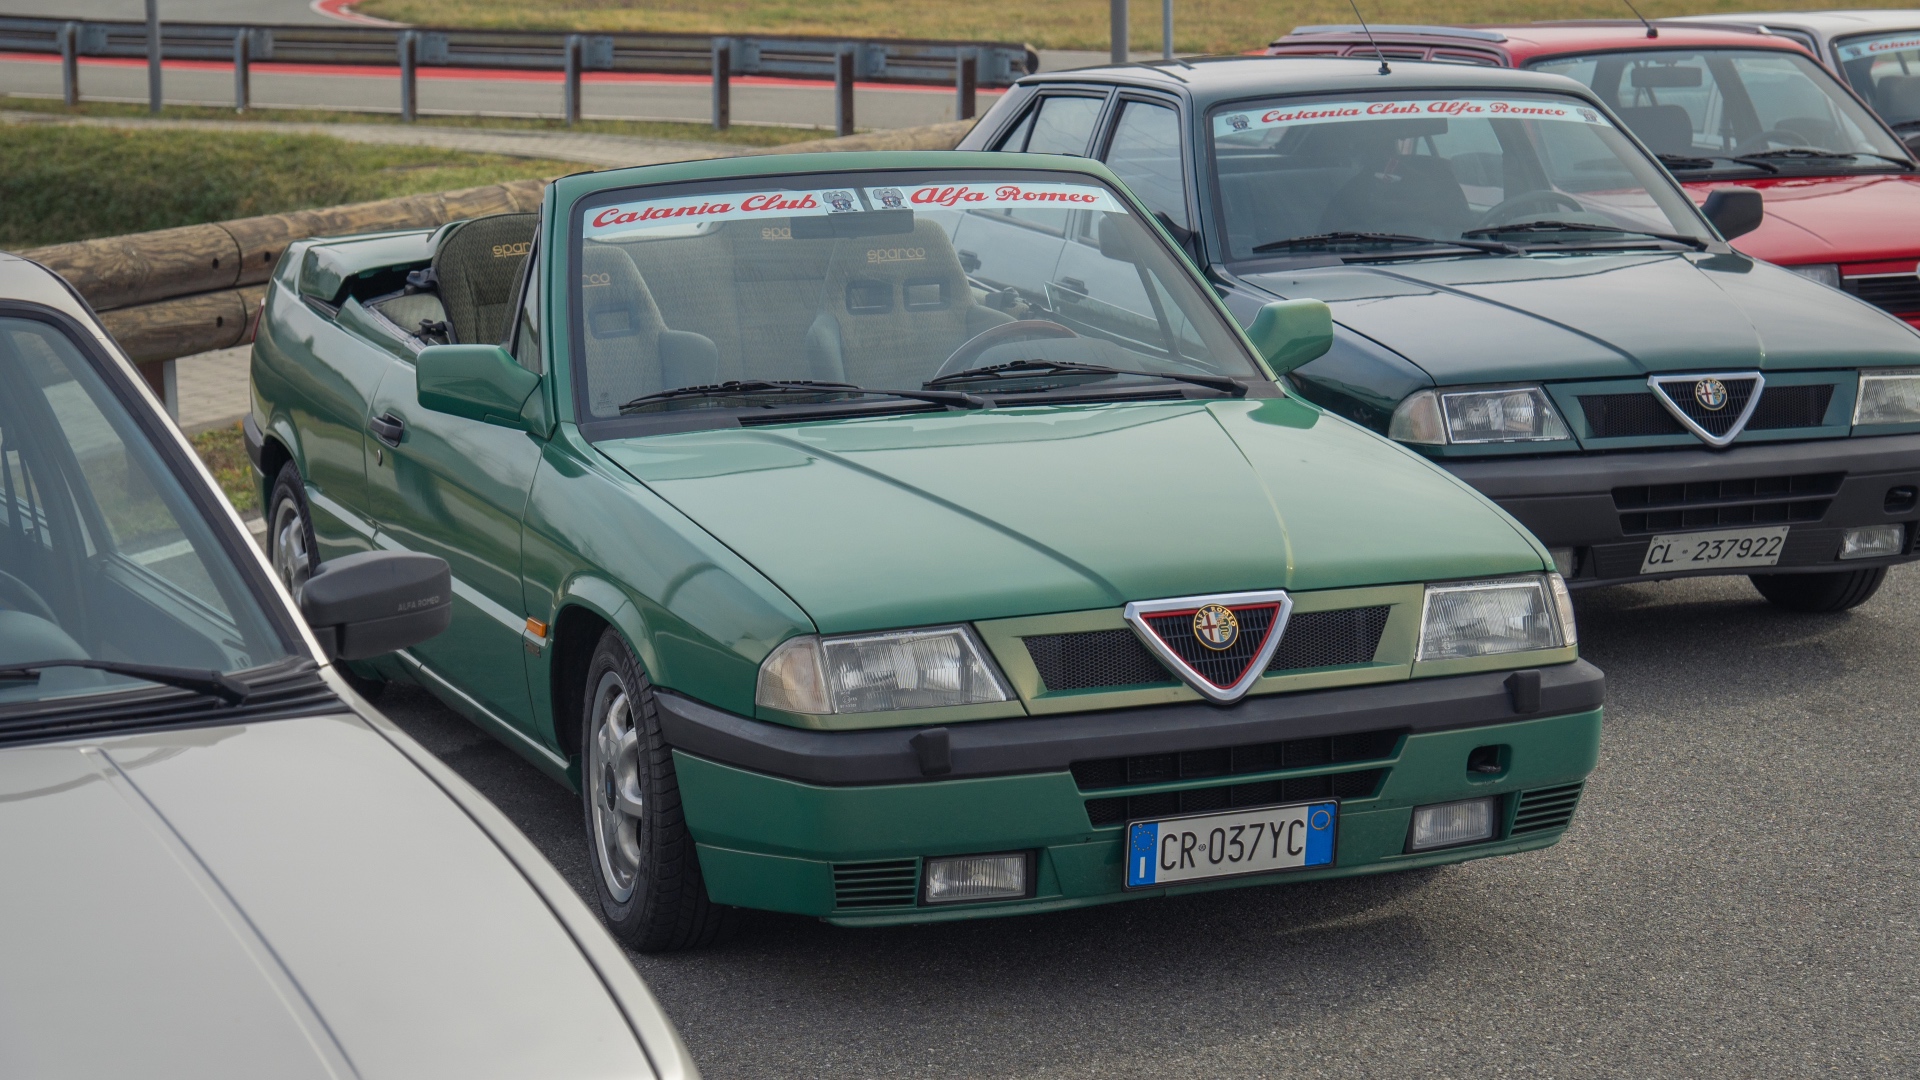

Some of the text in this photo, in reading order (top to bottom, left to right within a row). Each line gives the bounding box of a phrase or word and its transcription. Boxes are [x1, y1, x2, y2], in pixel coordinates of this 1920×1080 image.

[1868, 39, 1920, 52] Catani
[1261, 101, 1568, 123] Catania Club Alfa Romeo
[592, 185, 1099, 228] Catania Club Alfa Romeo
[762, 227, 791, 241] spa
[492, 241, 531, 258] spar
[867, 247, 926, 264] sparco
[1647, 536, 1782, 565] CL 237922
[398, 595, 439, 612] ALFA ROMEO
[1196, 606, 1236, 629] ALFA ROMEO
